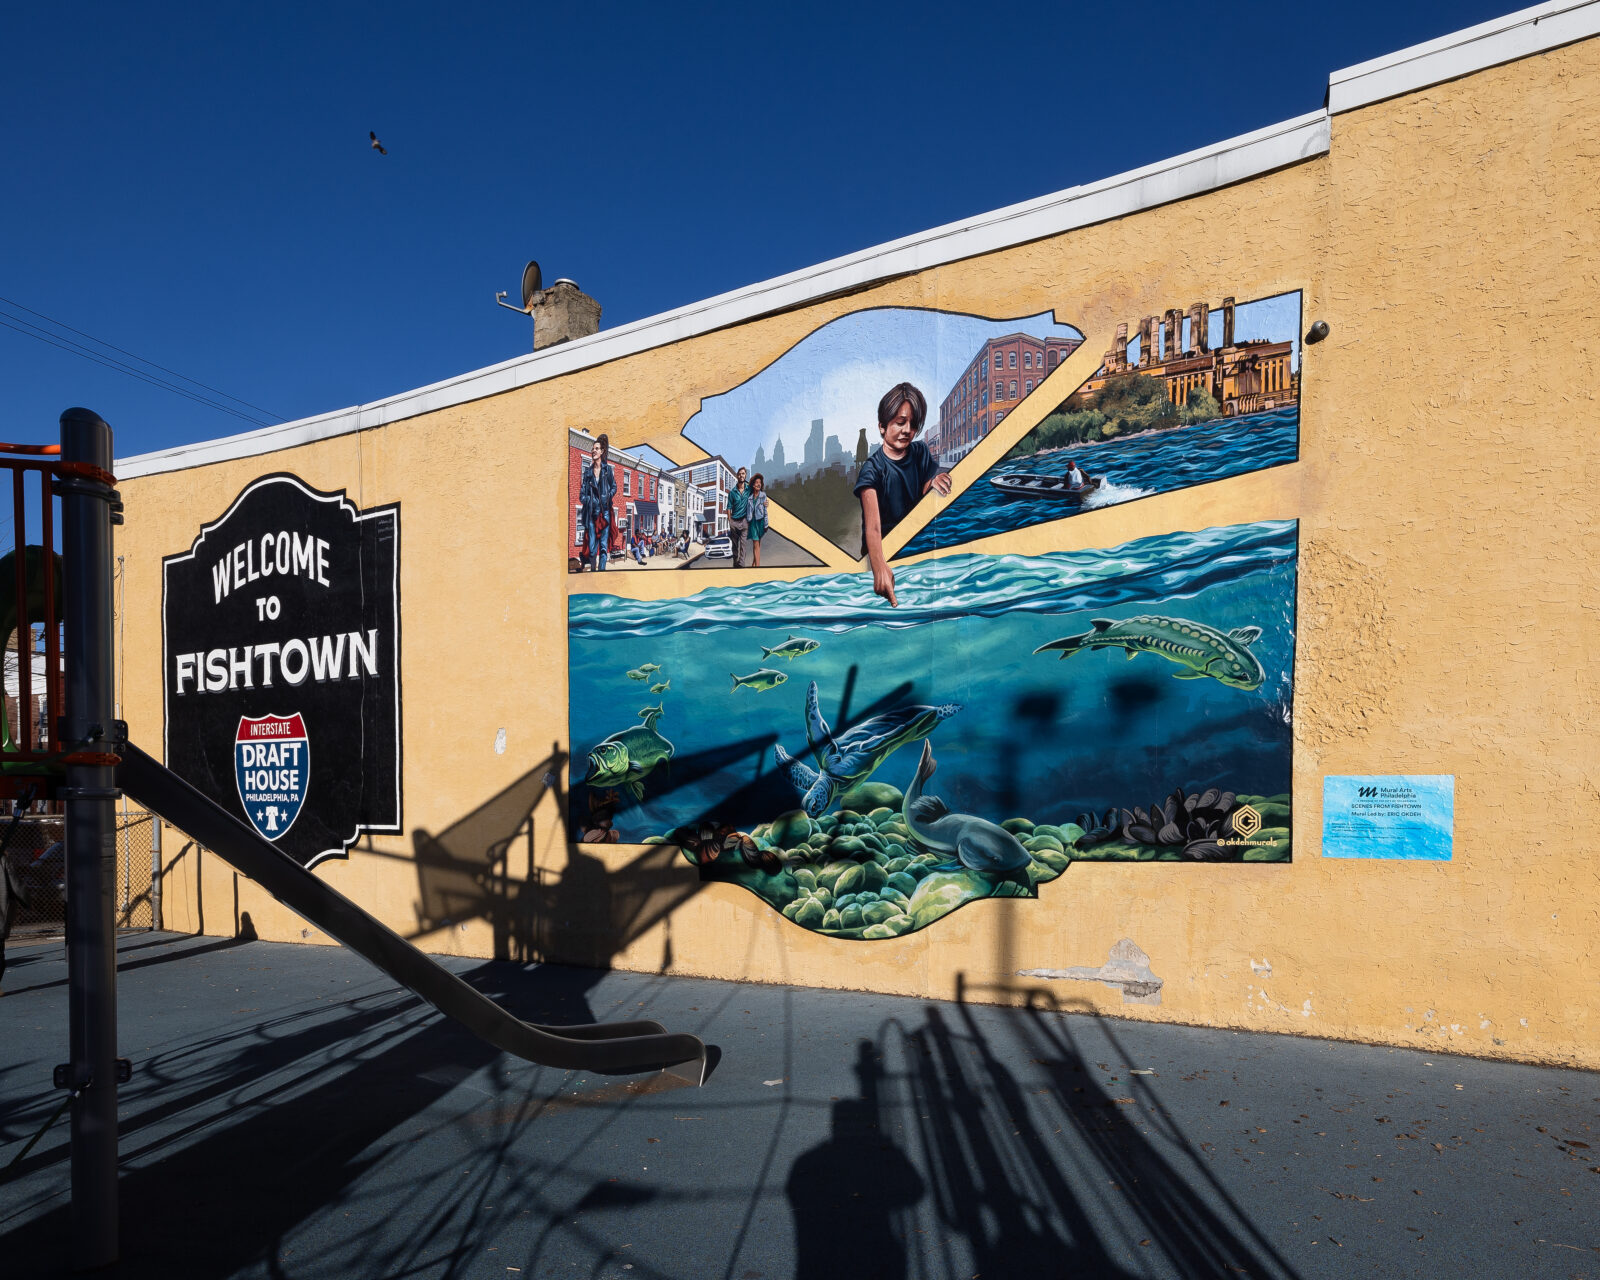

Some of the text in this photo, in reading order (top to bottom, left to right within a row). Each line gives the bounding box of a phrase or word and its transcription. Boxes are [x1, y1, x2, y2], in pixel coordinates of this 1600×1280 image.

[212, 530, 330, 605] WELCOME
[256, 595, 281, 622] TO
[176, 628, 380, 696] FISHTOWN
[250, 721, 291, 736] INTERSTATE
[241, 742, 302, 768] DRAFT
[245, 769, 300, 791] HOUSE
[245, 793, 299, 803] PHILADELPHIA, PA
